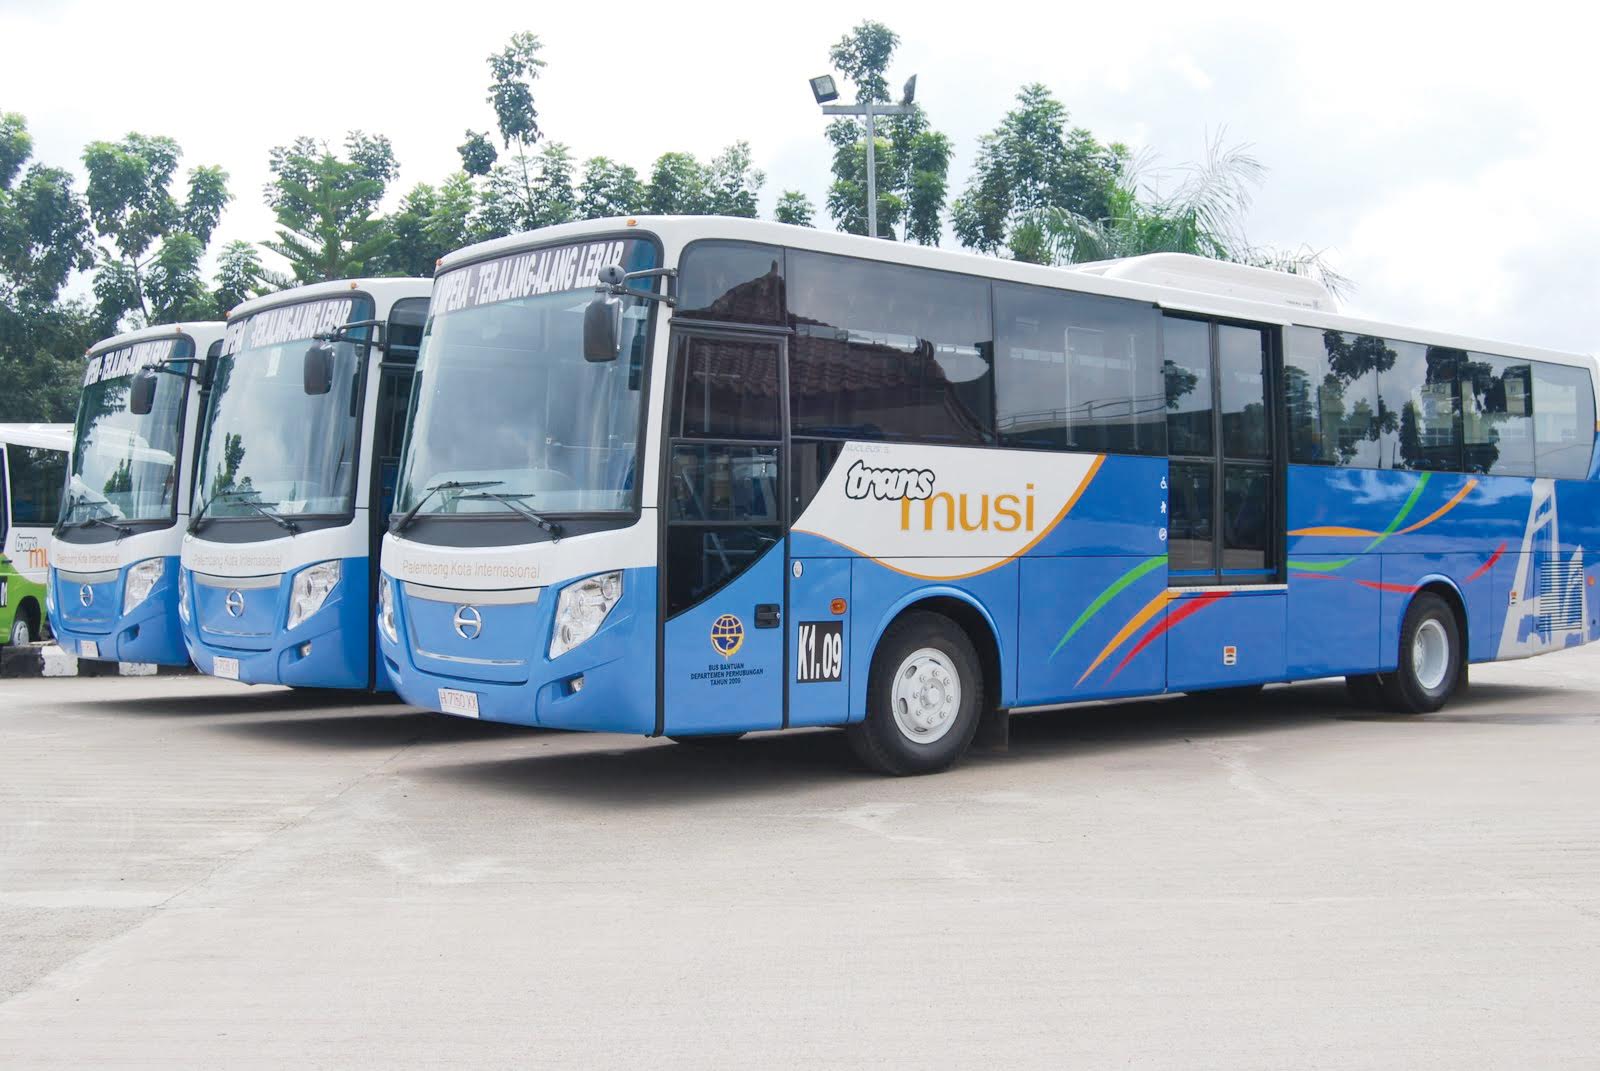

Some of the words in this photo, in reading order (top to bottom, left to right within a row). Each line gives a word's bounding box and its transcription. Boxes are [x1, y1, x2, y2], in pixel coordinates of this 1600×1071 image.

[845, 459, 936, 501] trans
[901, 483, 1034, 531] musi
[402, 559, 449, 579] Palembang
[451, 561, 472, 576] Kota
[474, 562, 540, 579] Internasional
[797, 624, 842, 680] K1.09
